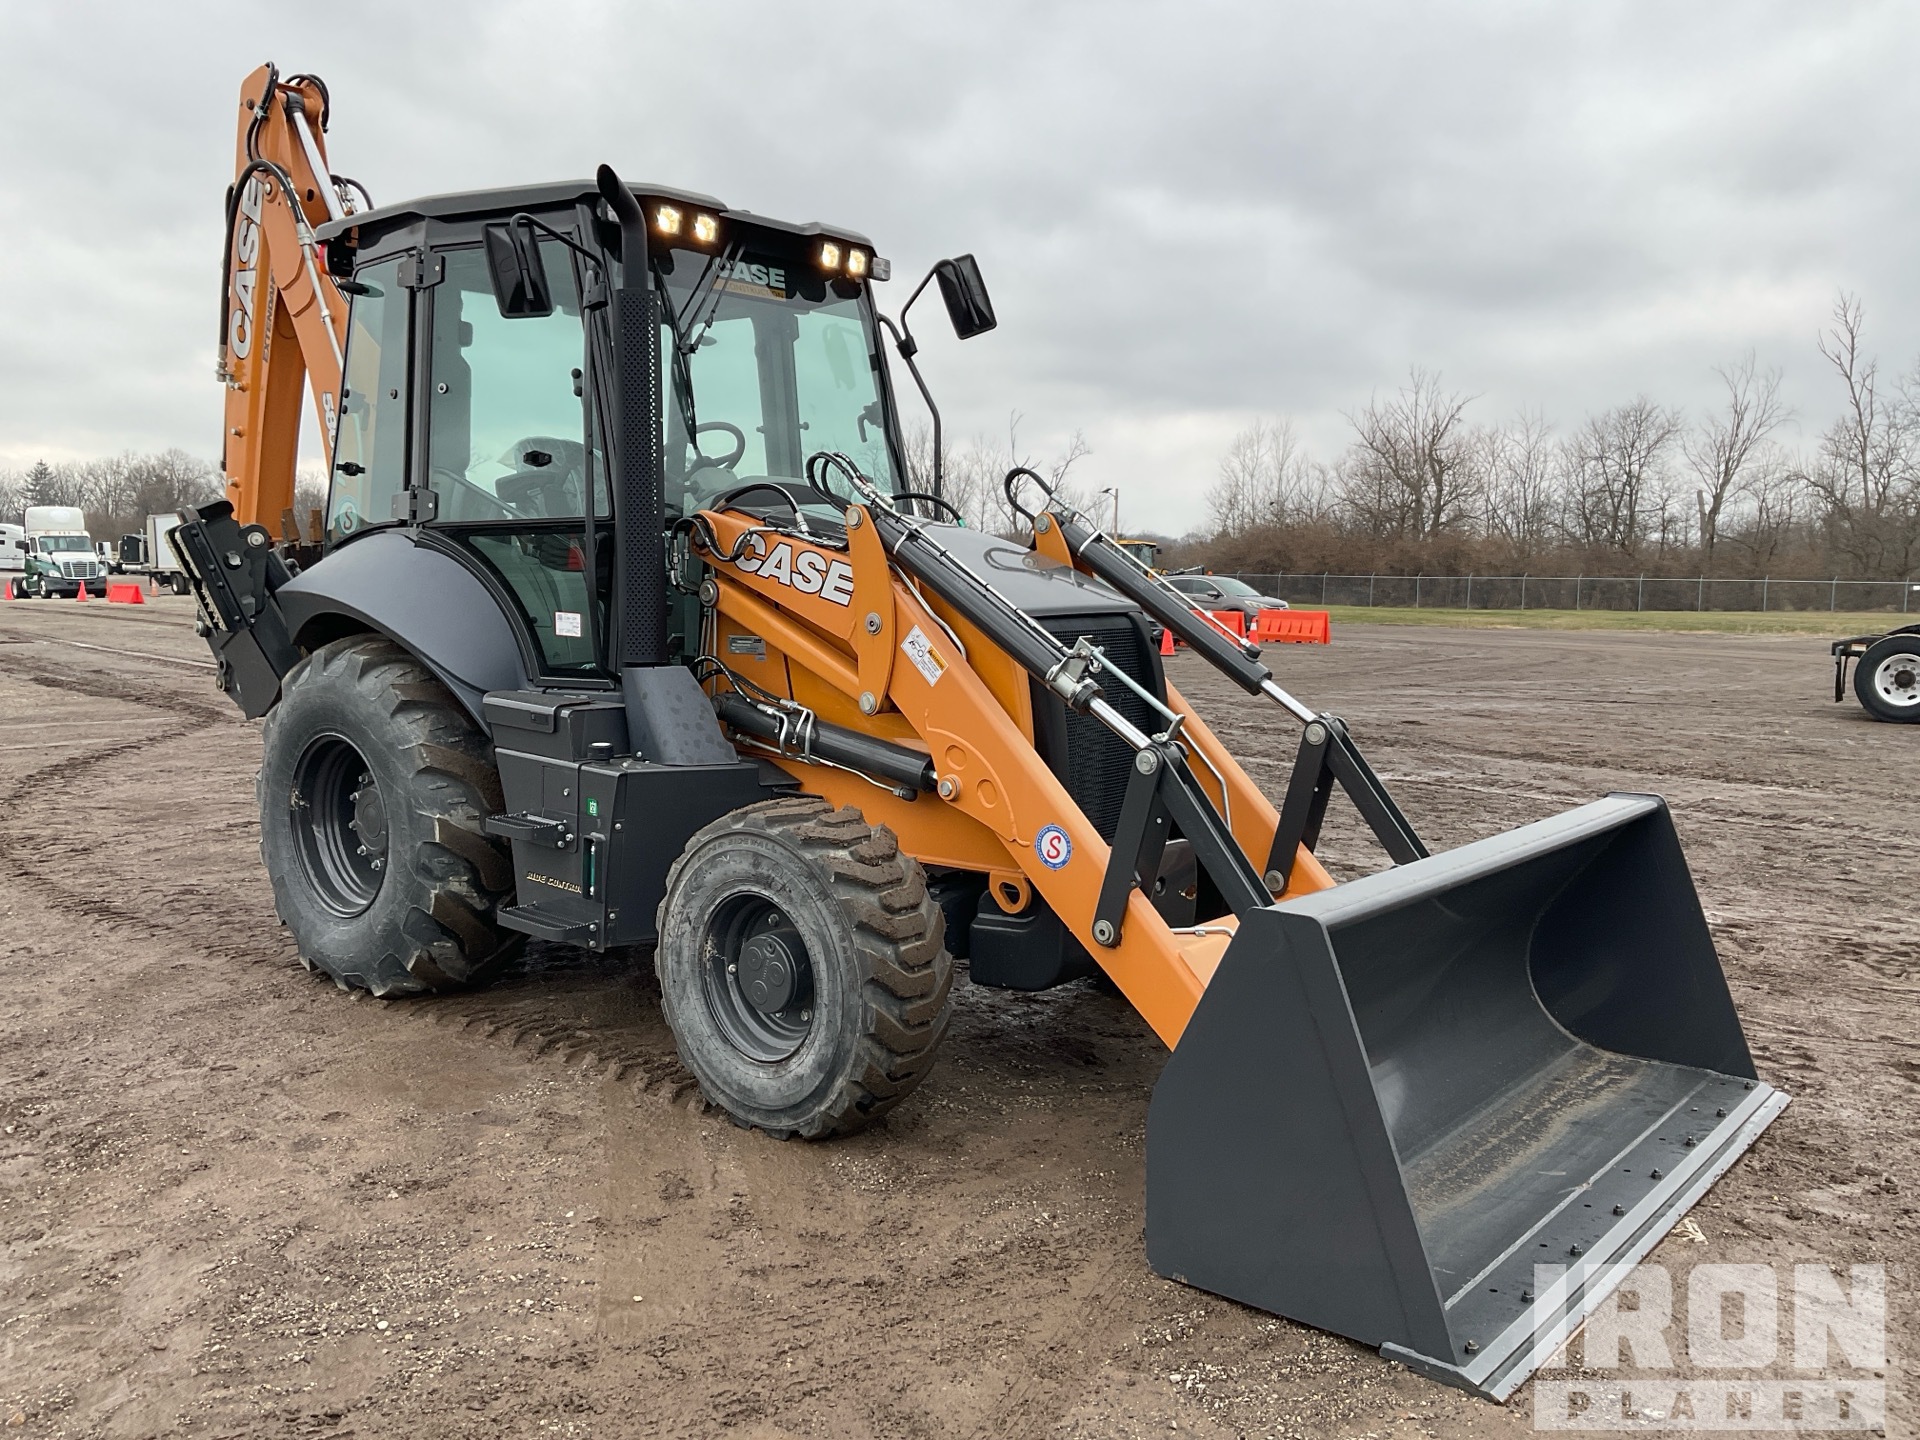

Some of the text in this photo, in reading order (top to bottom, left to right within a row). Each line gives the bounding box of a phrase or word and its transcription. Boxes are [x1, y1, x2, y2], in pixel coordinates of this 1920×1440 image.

[231, 175, 264, 359] CASE
[712, 257, 785, 289] CASE
[263, 268, 275, 363] EXTENDAH
[734, 533, 853, 606] CASE
[1046, 835, 1062, 859] S
